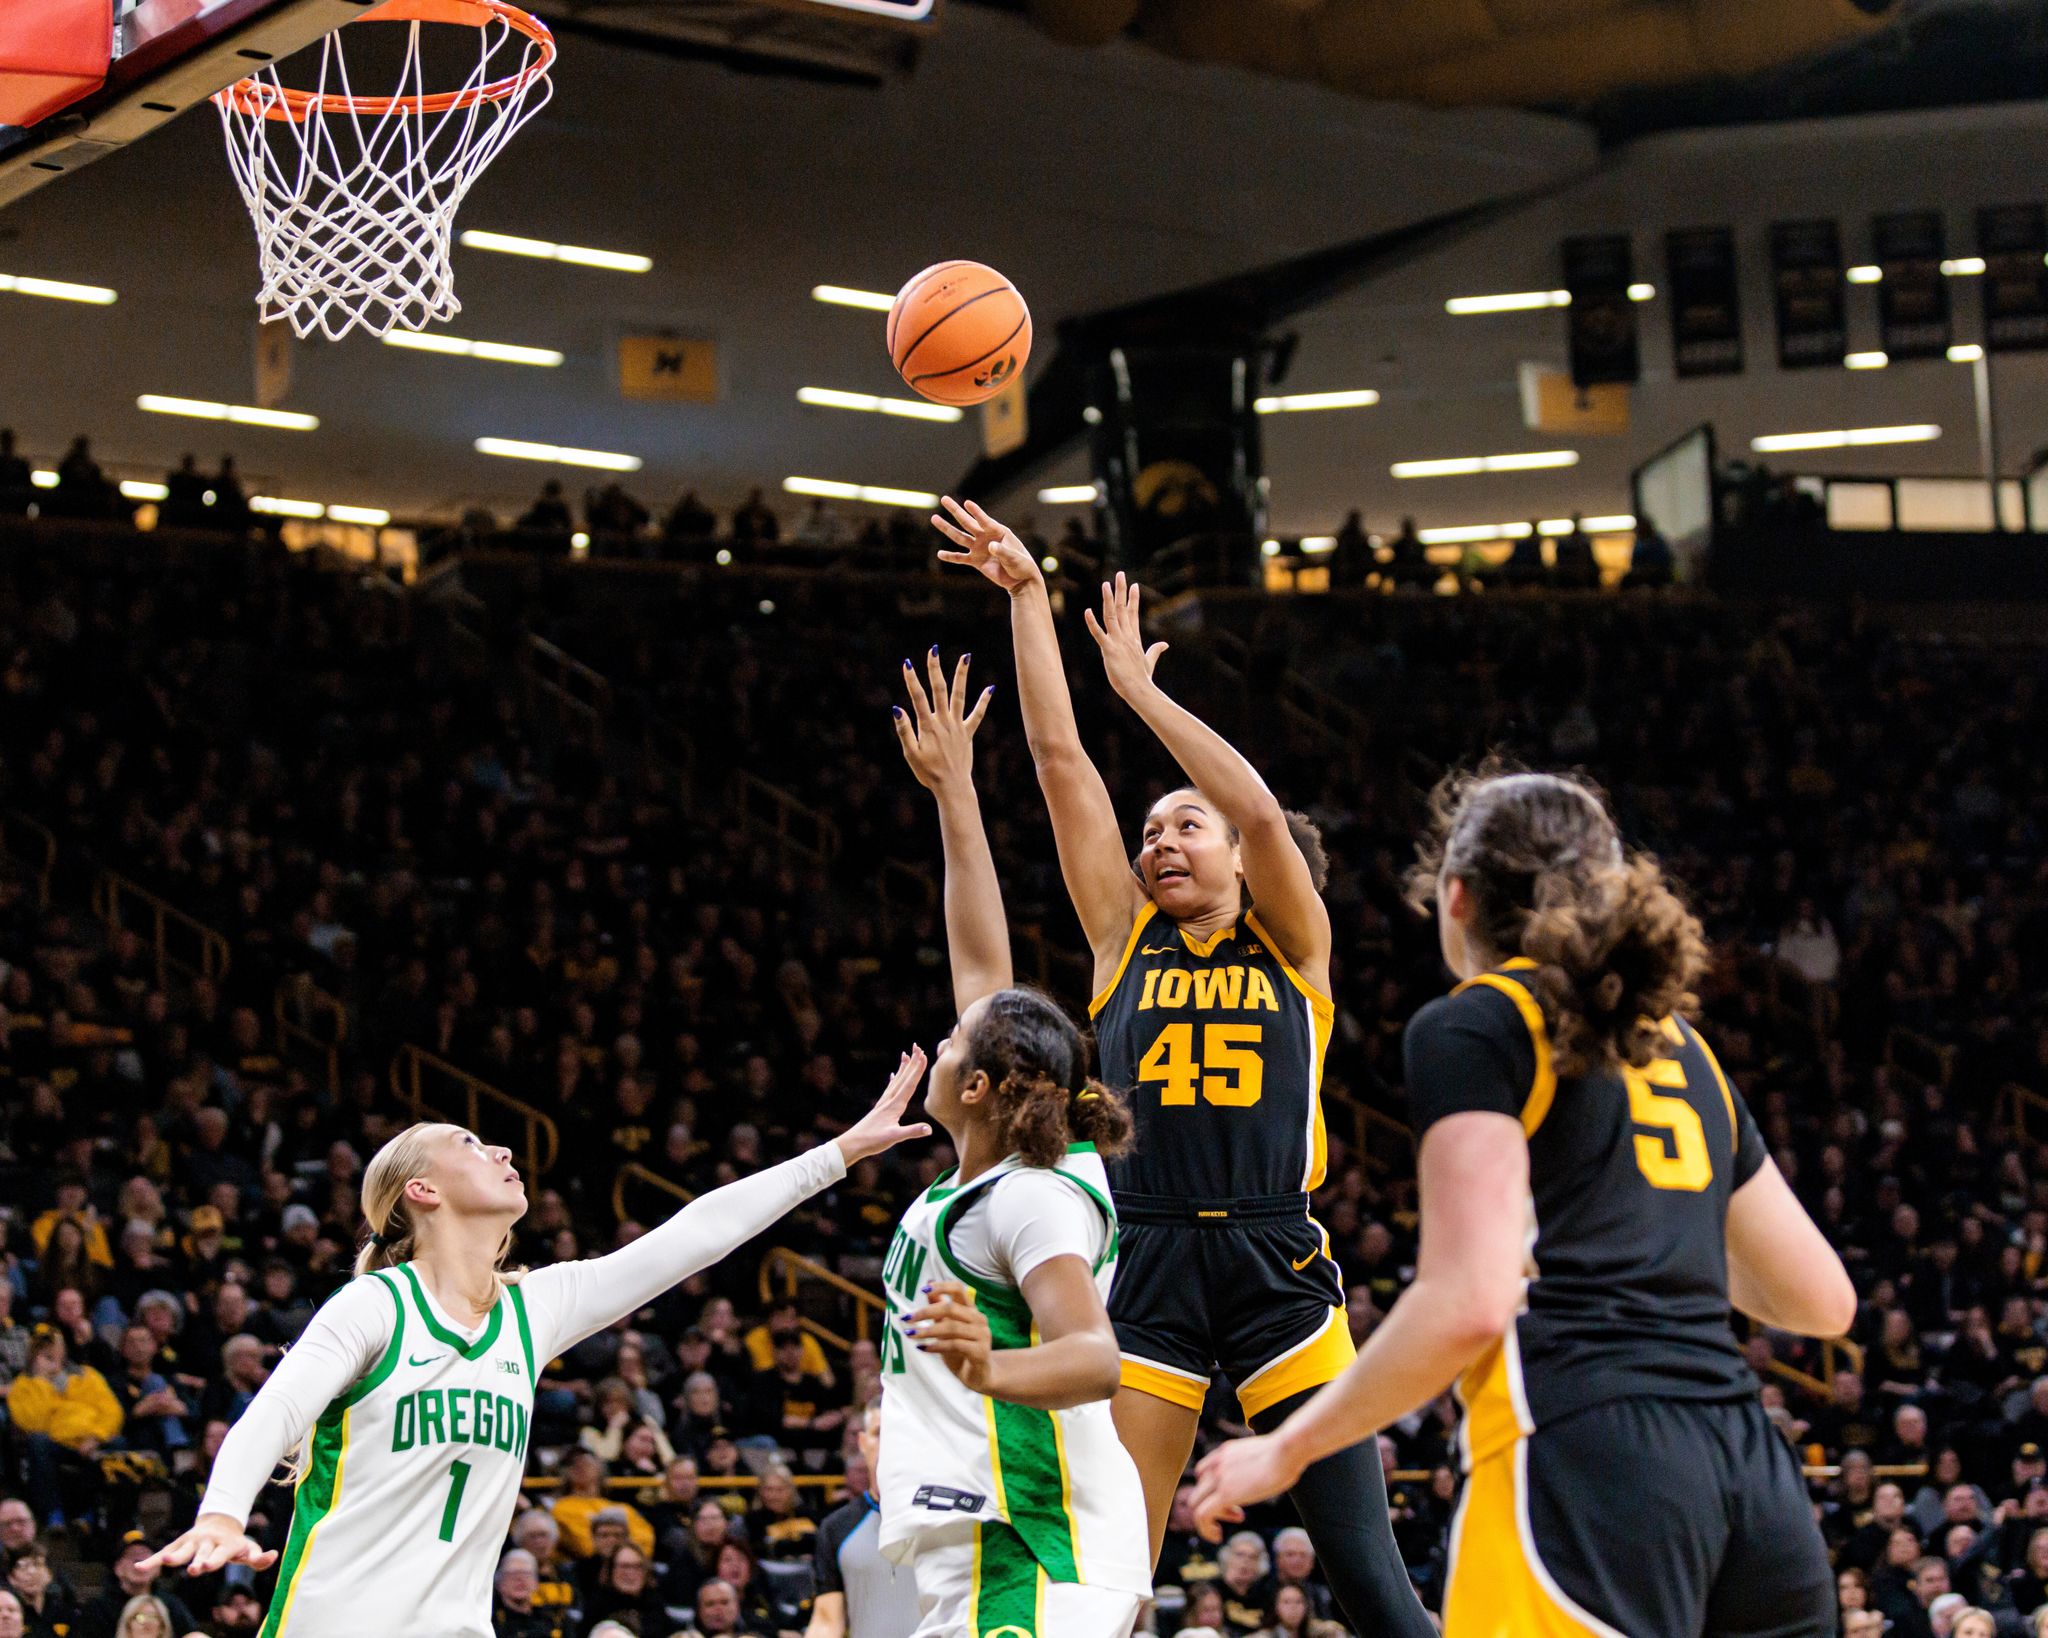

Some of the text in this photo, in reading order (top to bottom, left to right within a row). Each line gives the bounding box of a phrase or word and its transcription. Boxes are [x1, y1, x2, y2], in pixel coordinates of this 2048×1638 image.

[1137, 965, 1280, 1012] IOWA
[1138, 1023, 1264, 1107] 45
[1622, 1057, 1714, 1192] 5
[884, 1223, 927, 1302] ON
[391, 1388, 528, 1464] OREGON
[438, 1459, 472, 1543] 1
